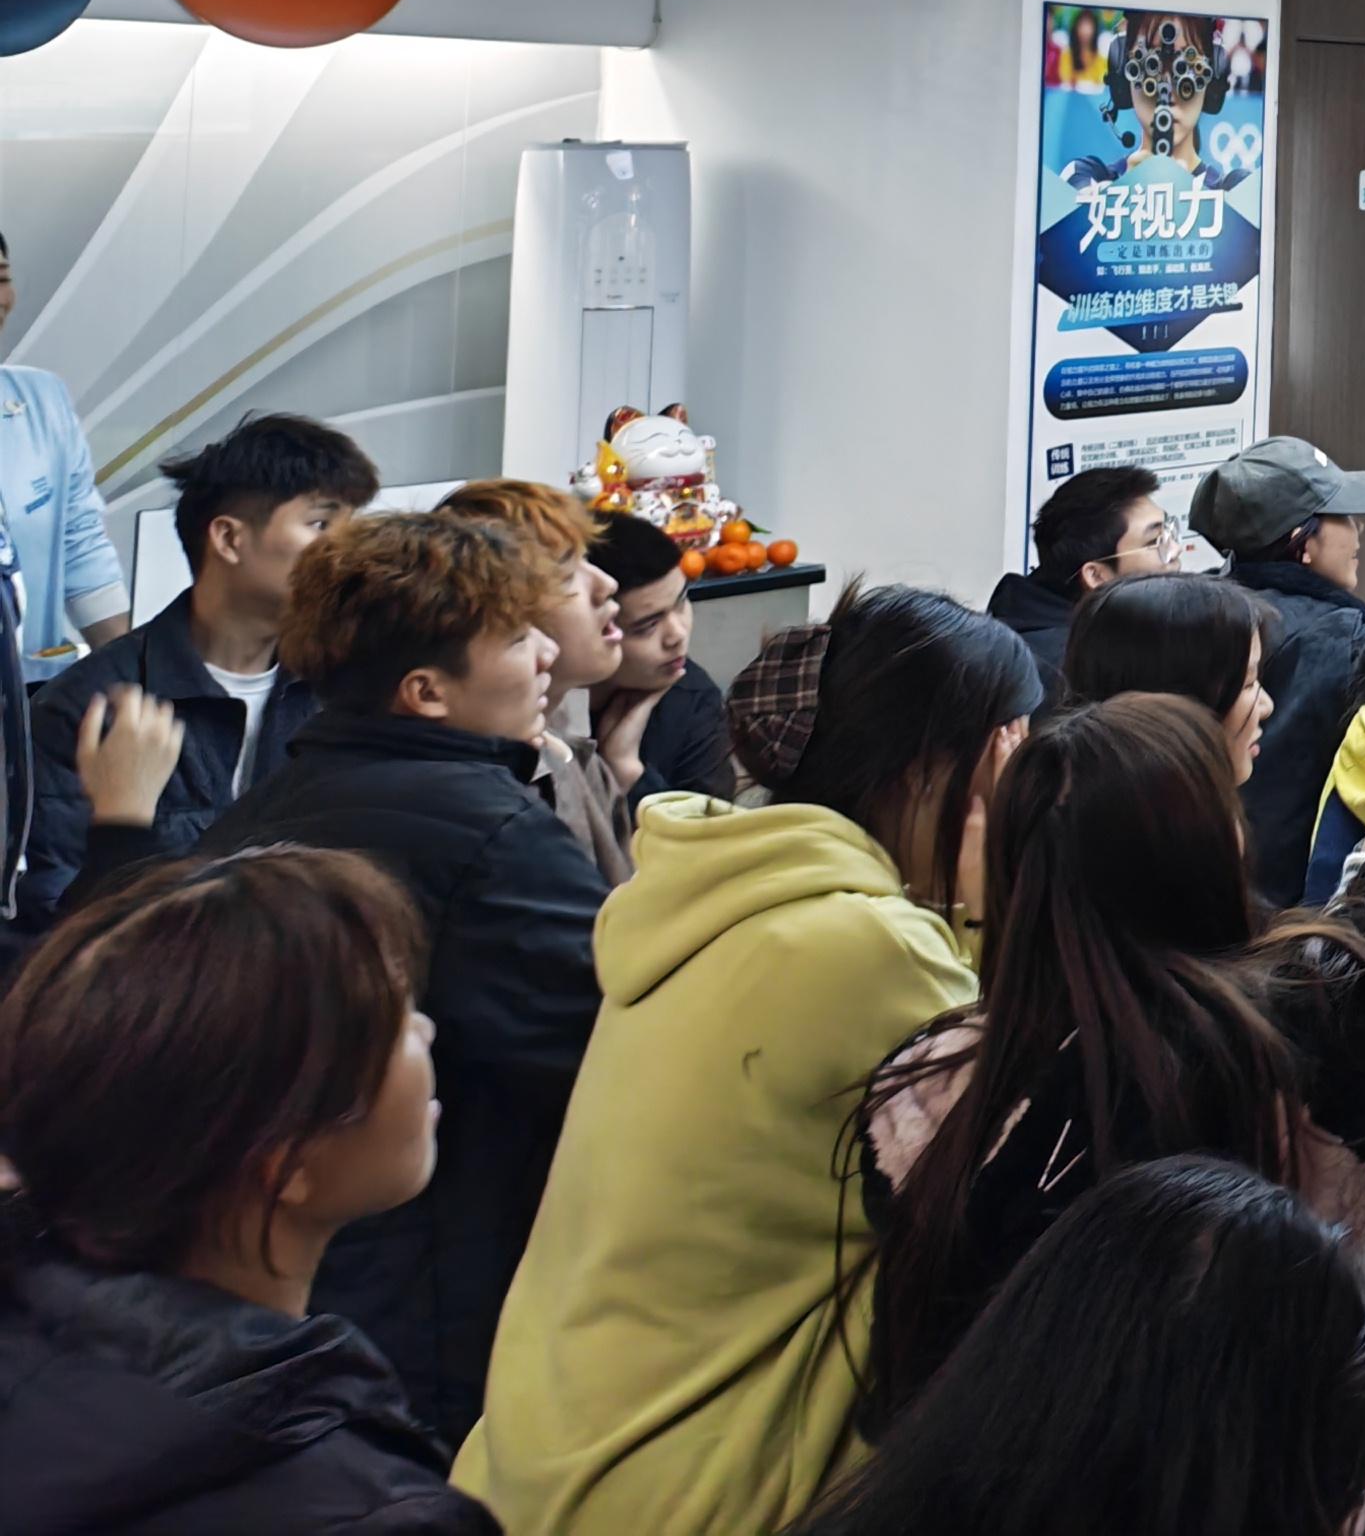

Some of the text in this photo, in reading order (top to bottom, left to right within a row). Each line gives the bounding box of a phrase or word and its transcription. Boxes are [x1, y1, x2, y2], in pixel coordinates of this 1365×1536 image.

[1076, 172, 1224, 253] 好视力
[1067, 282, 1239, 321] 训练的维度才是关键
